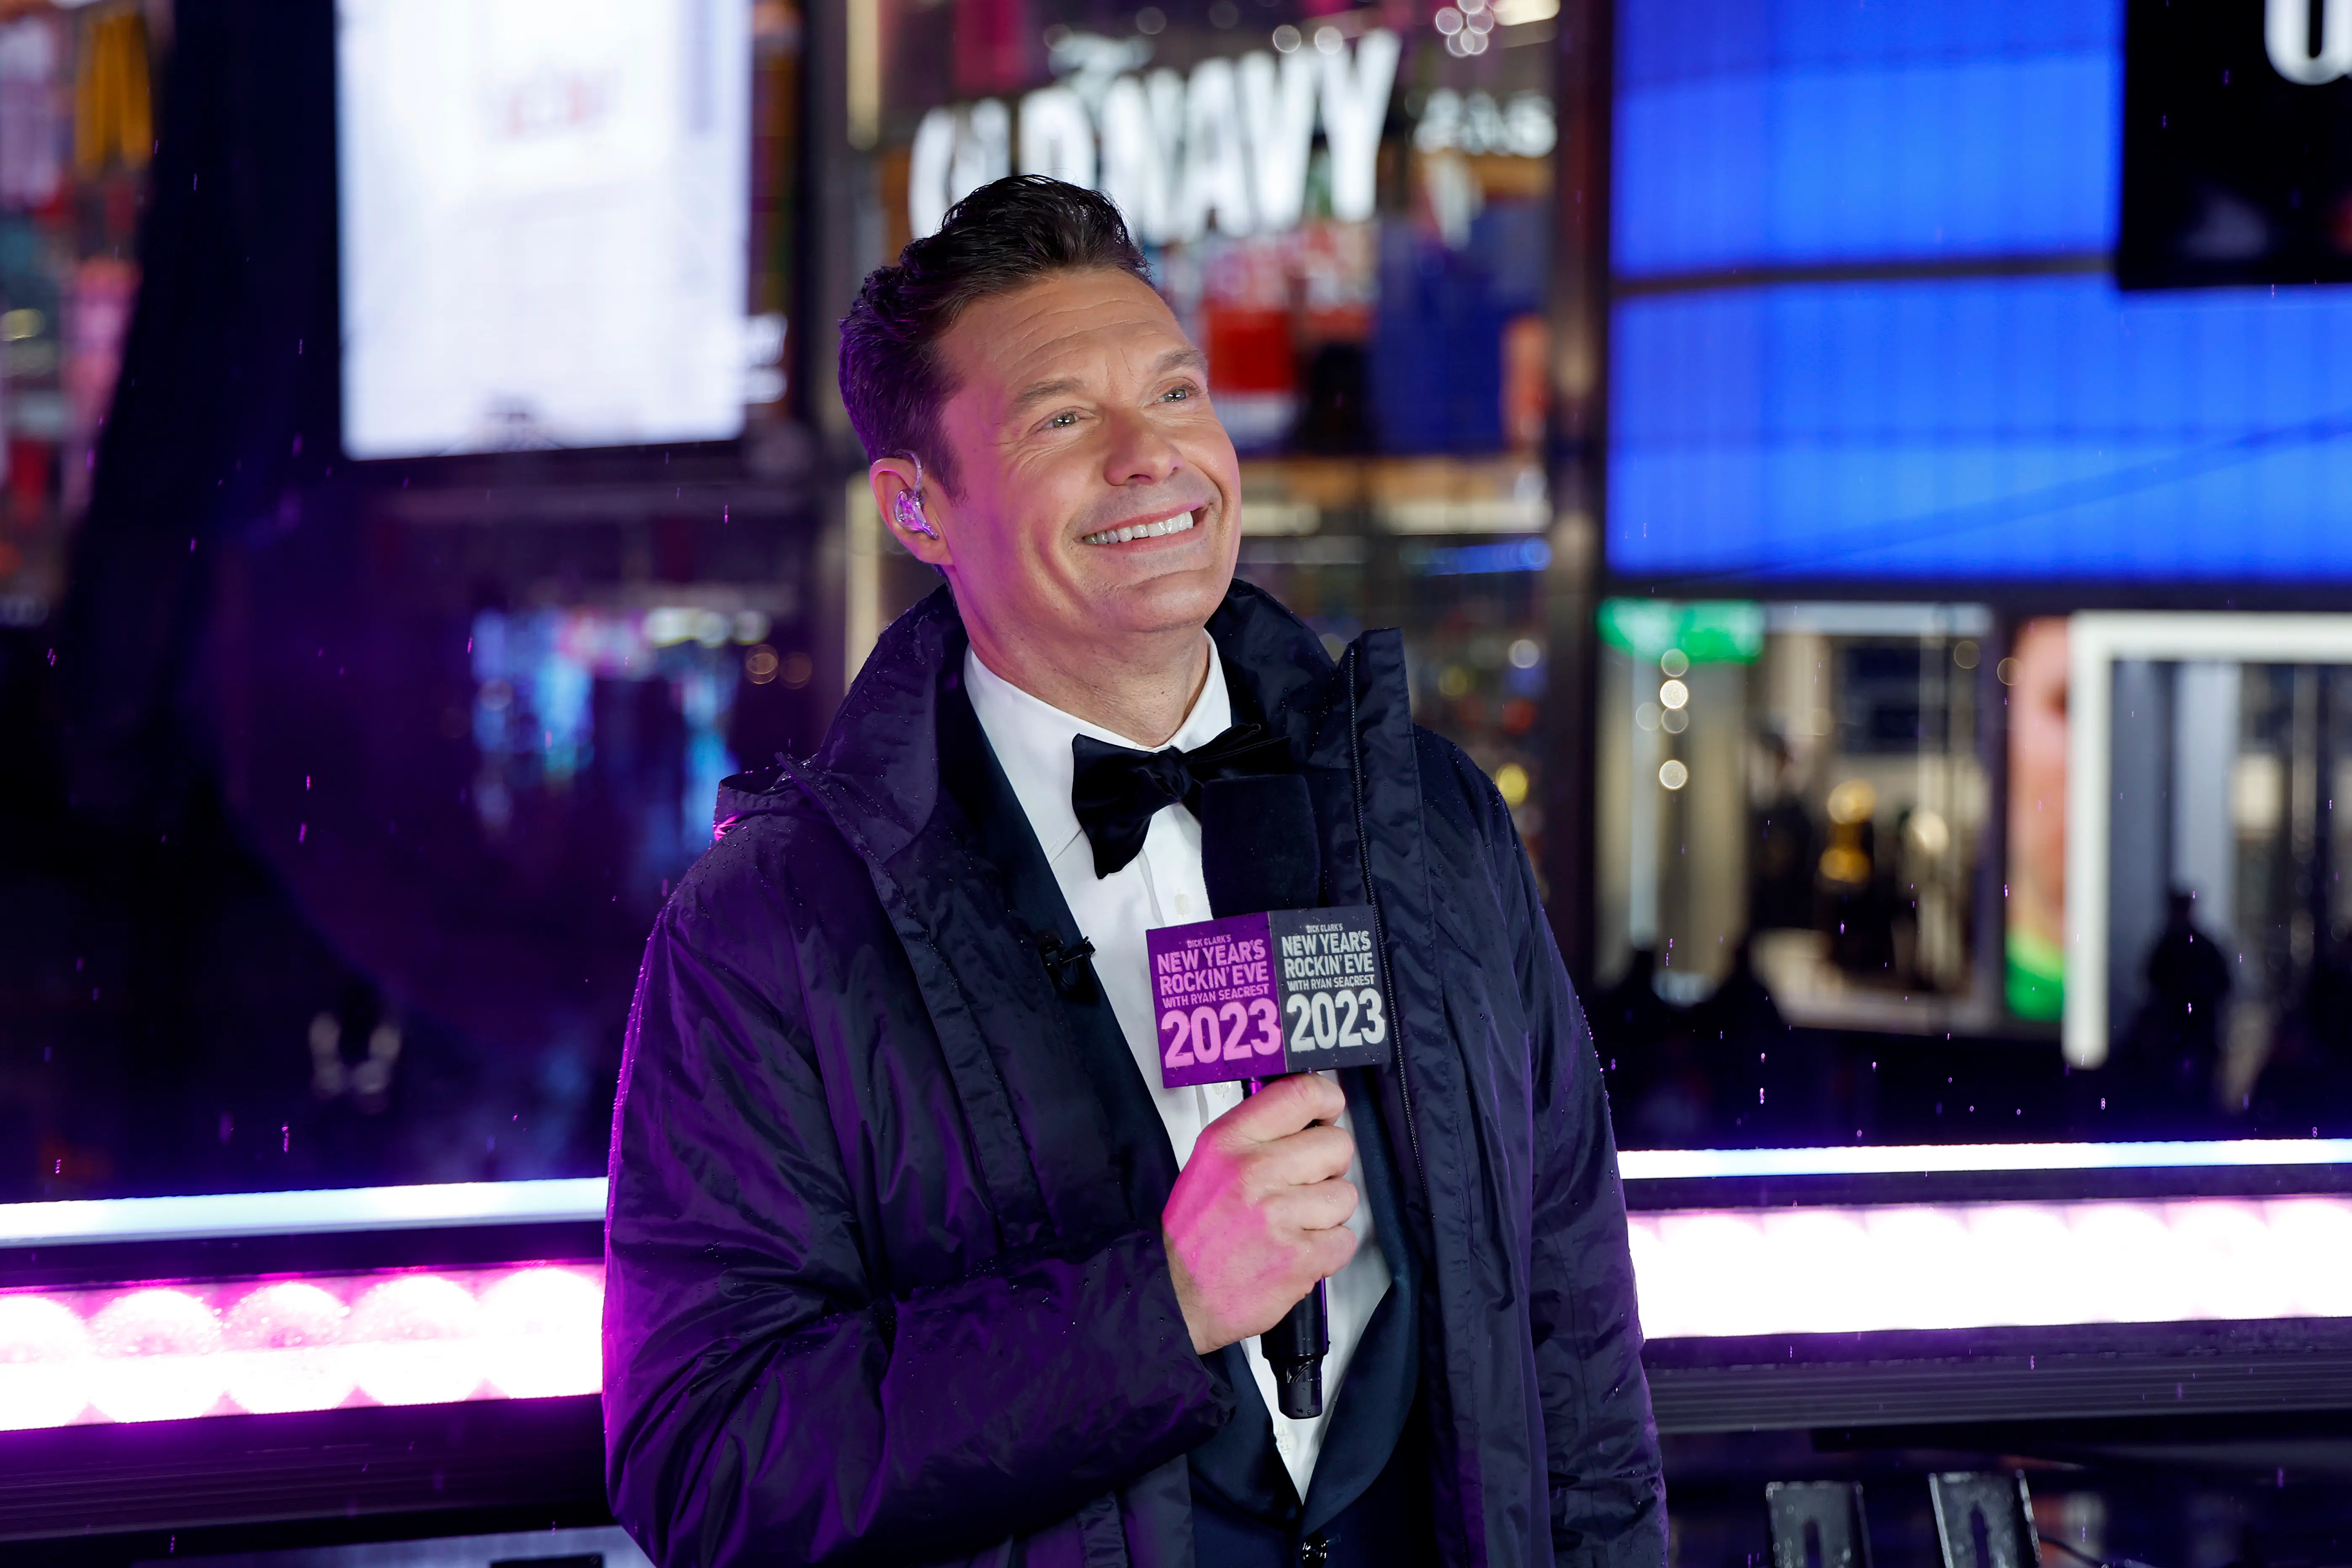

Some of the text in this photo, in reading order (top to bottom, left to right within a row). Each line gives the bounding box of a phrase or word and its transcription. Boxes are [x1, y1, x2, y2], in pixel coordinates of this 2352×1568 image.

[1101, 27, 1401, 247] NAVY
[1186, 934, 1231, 948] DICK CLARK'S
[1306, 923, 1343, 933] DICK CLARK'S
[1157, 939, 1266, 974] NEW YEAR'S
[1281, 930, 1371, 956] NEW YEAR'S
[1159, 961, 1269, 996] ROCKIN' EVE
[1284, 952, 1374, 979] ROCKIN' EVE
[1162, 983, 1269, 1008] WITH RYAN SEACREST
[1287, 974, 1374, 991] WITH RYAN SEACREST
[1161, 998, 1282, 1068] 2023
[1286, 988, 1386, 1052] 2023
